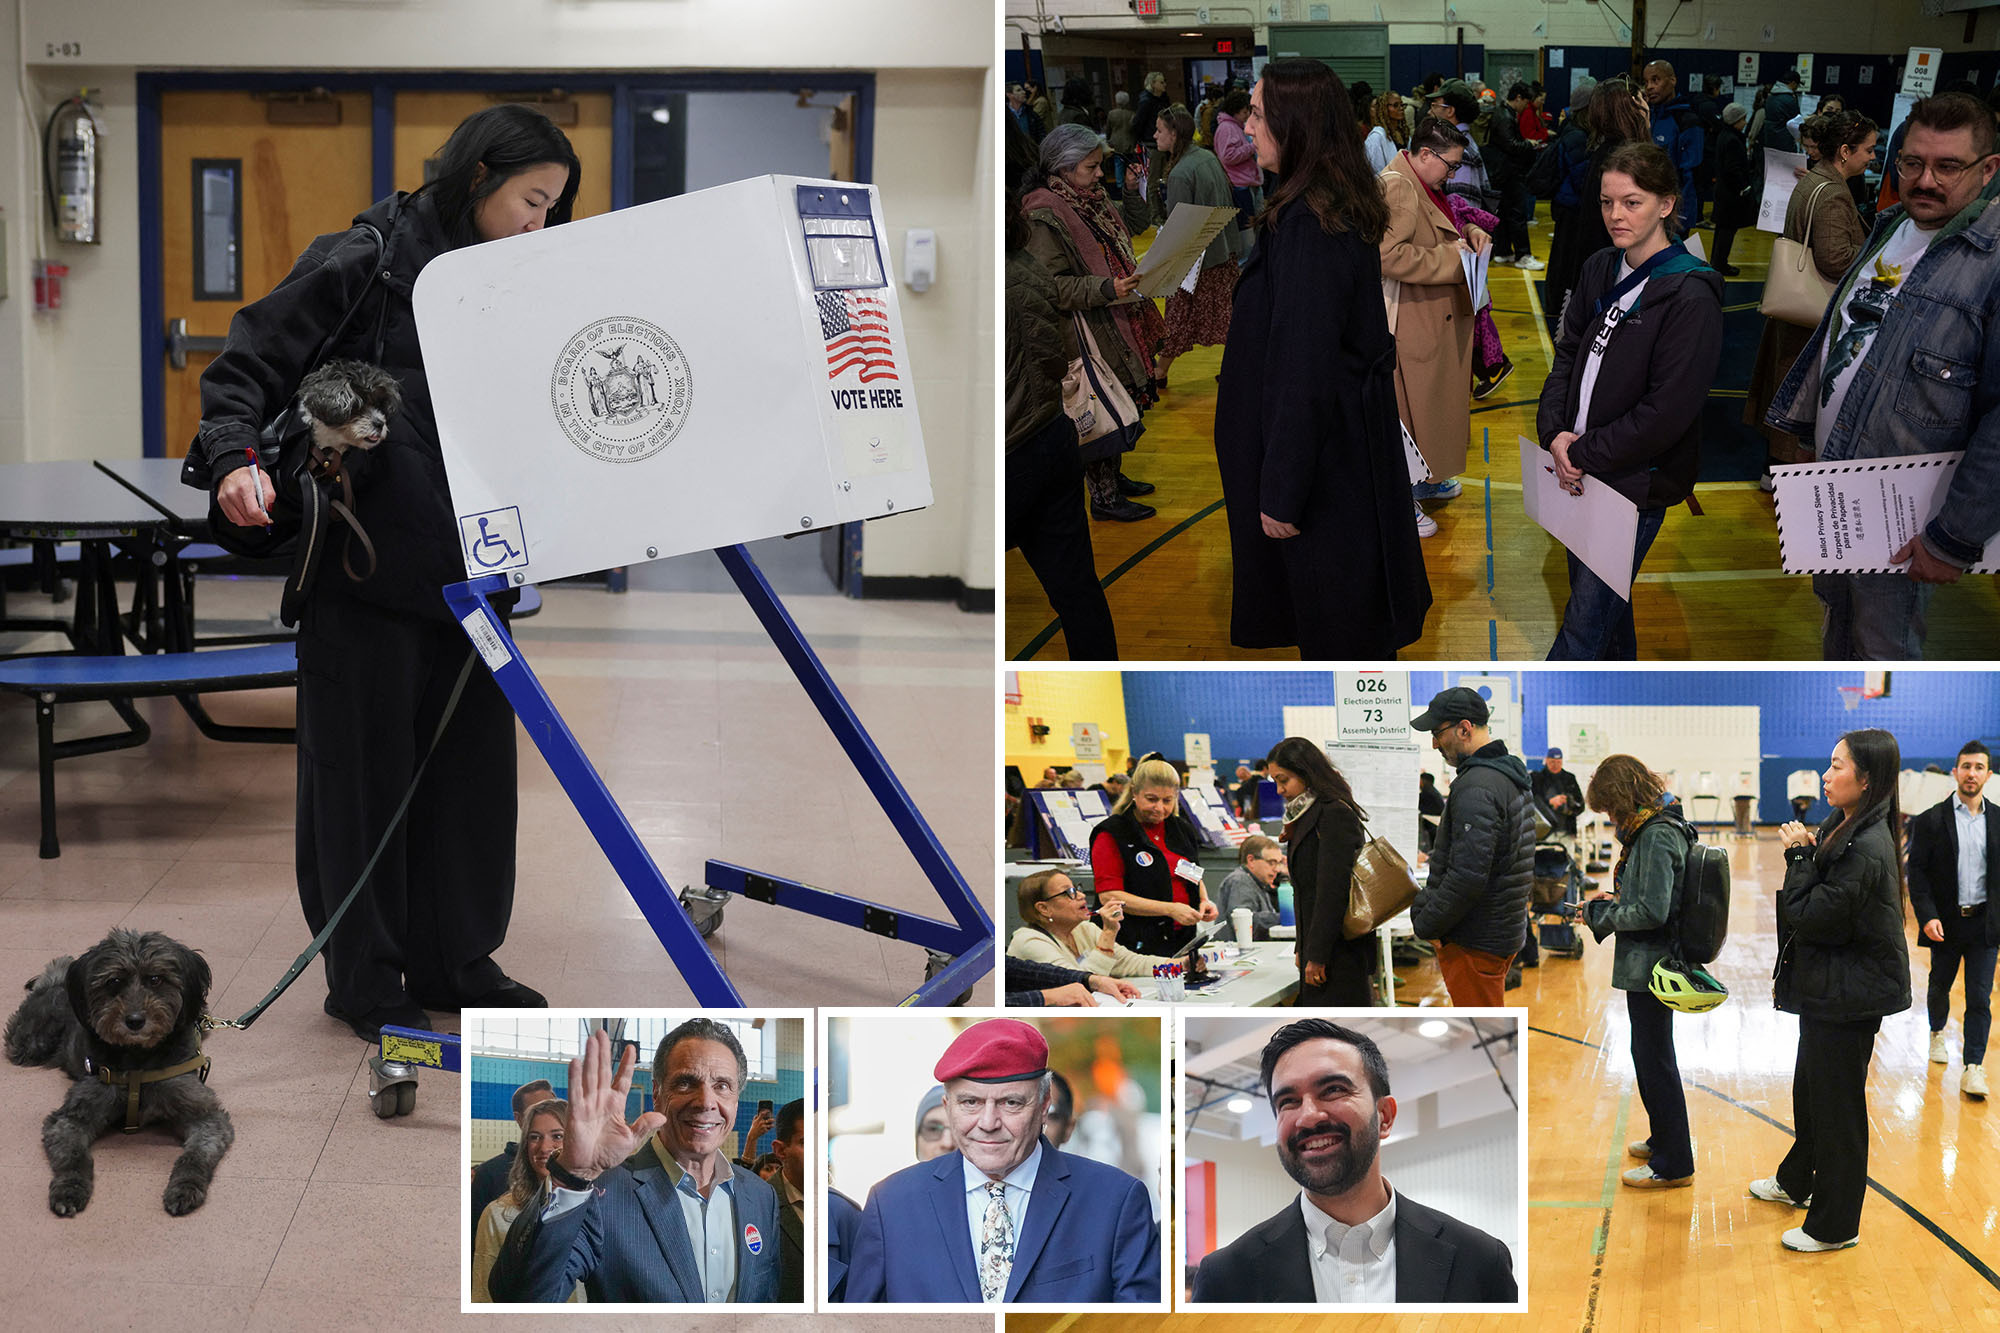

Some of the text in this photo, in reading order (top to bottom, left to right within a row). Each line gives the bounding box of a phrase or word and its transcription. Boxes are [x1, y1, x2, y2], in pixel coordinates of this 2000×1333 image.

[1138, 0, 1157, 14] EXIT
[1199, 10, 1207, 19] G
[1217, 41, 1232, 53] EXIT
[558, 323, 677, 386] BOARD OF ELECTIONS
[831, 389, 904, 410] VOTE HERE
[560, 376, 686, 456] IN THE CITY OF NEW YORK
[1838, 492, 1847, 522] Papeleta
[1814, 486, 1827, 558] Ballot Privacy Sleeve
[1827, 483, 1843, 559] Carpeta de Privacidad
[1356, 679, 1387, 692] 026
[1343, 697, 1402, 705] Election District
[1363, 709, 1383, 722] 73
[1342, 726, 1407, 736] Assembly District
